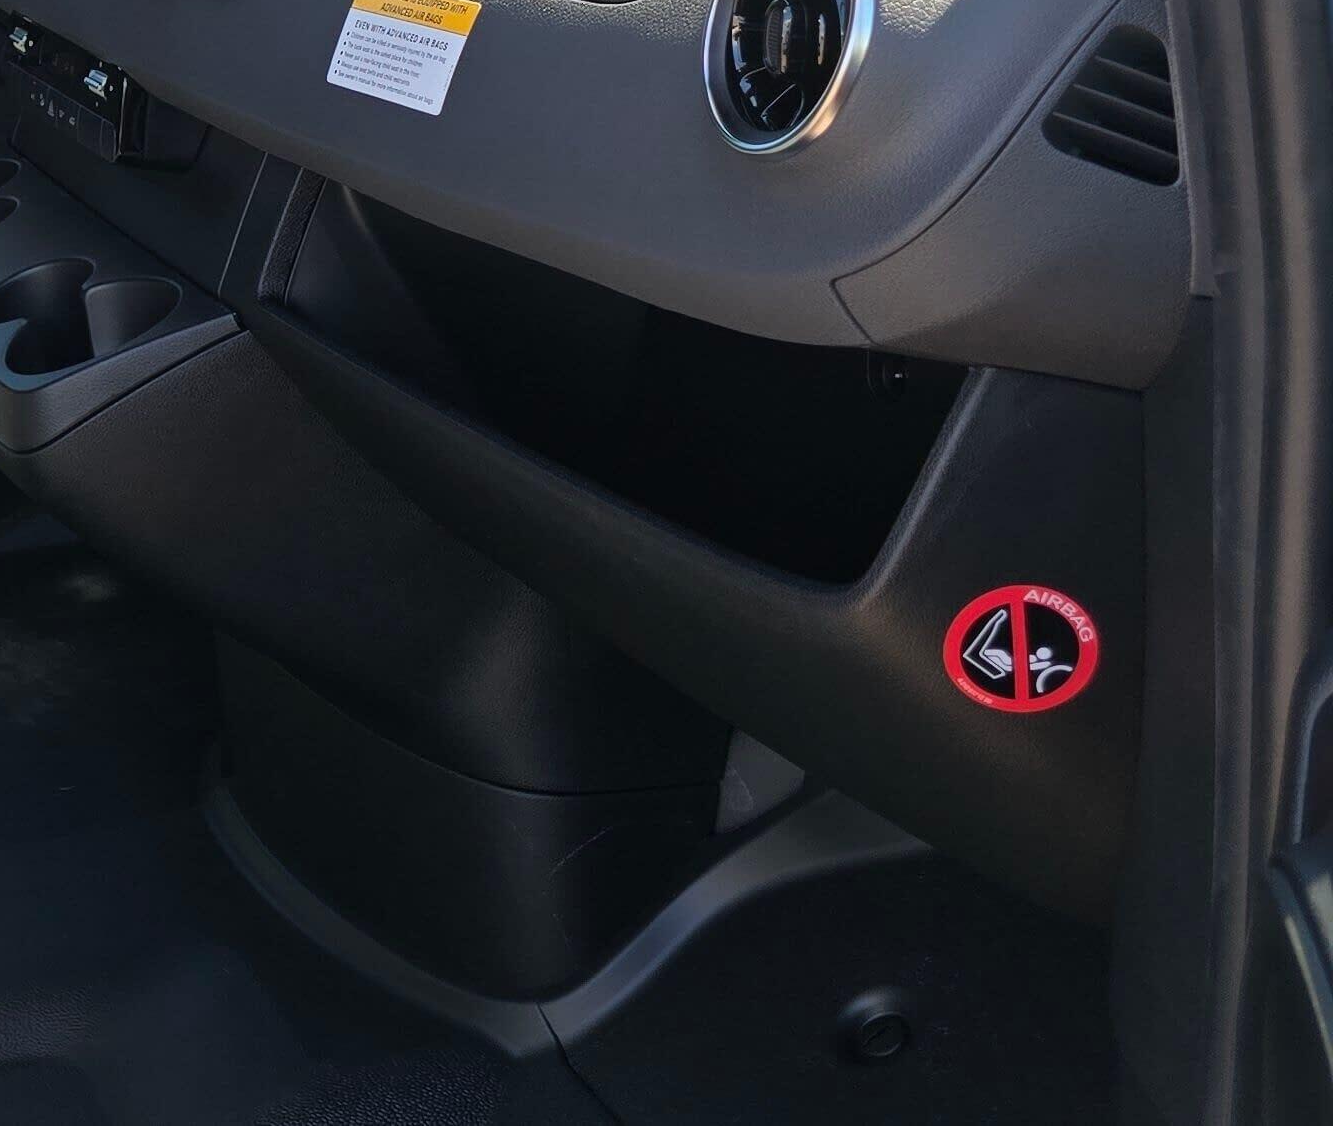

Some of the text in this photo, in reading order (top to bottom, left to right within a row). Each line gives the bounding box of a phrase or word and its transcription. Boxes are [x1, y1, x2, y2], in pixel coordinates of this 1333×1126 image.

[381, 3, 443, 25] ADVANCED AIR BAGS
[451, 2, 468, 15] WITH
[355, 19, 448, 51] EVEN WITH ADVANCED AIR BAGS
[1023, 589, 1094, 643] AIRBAG
